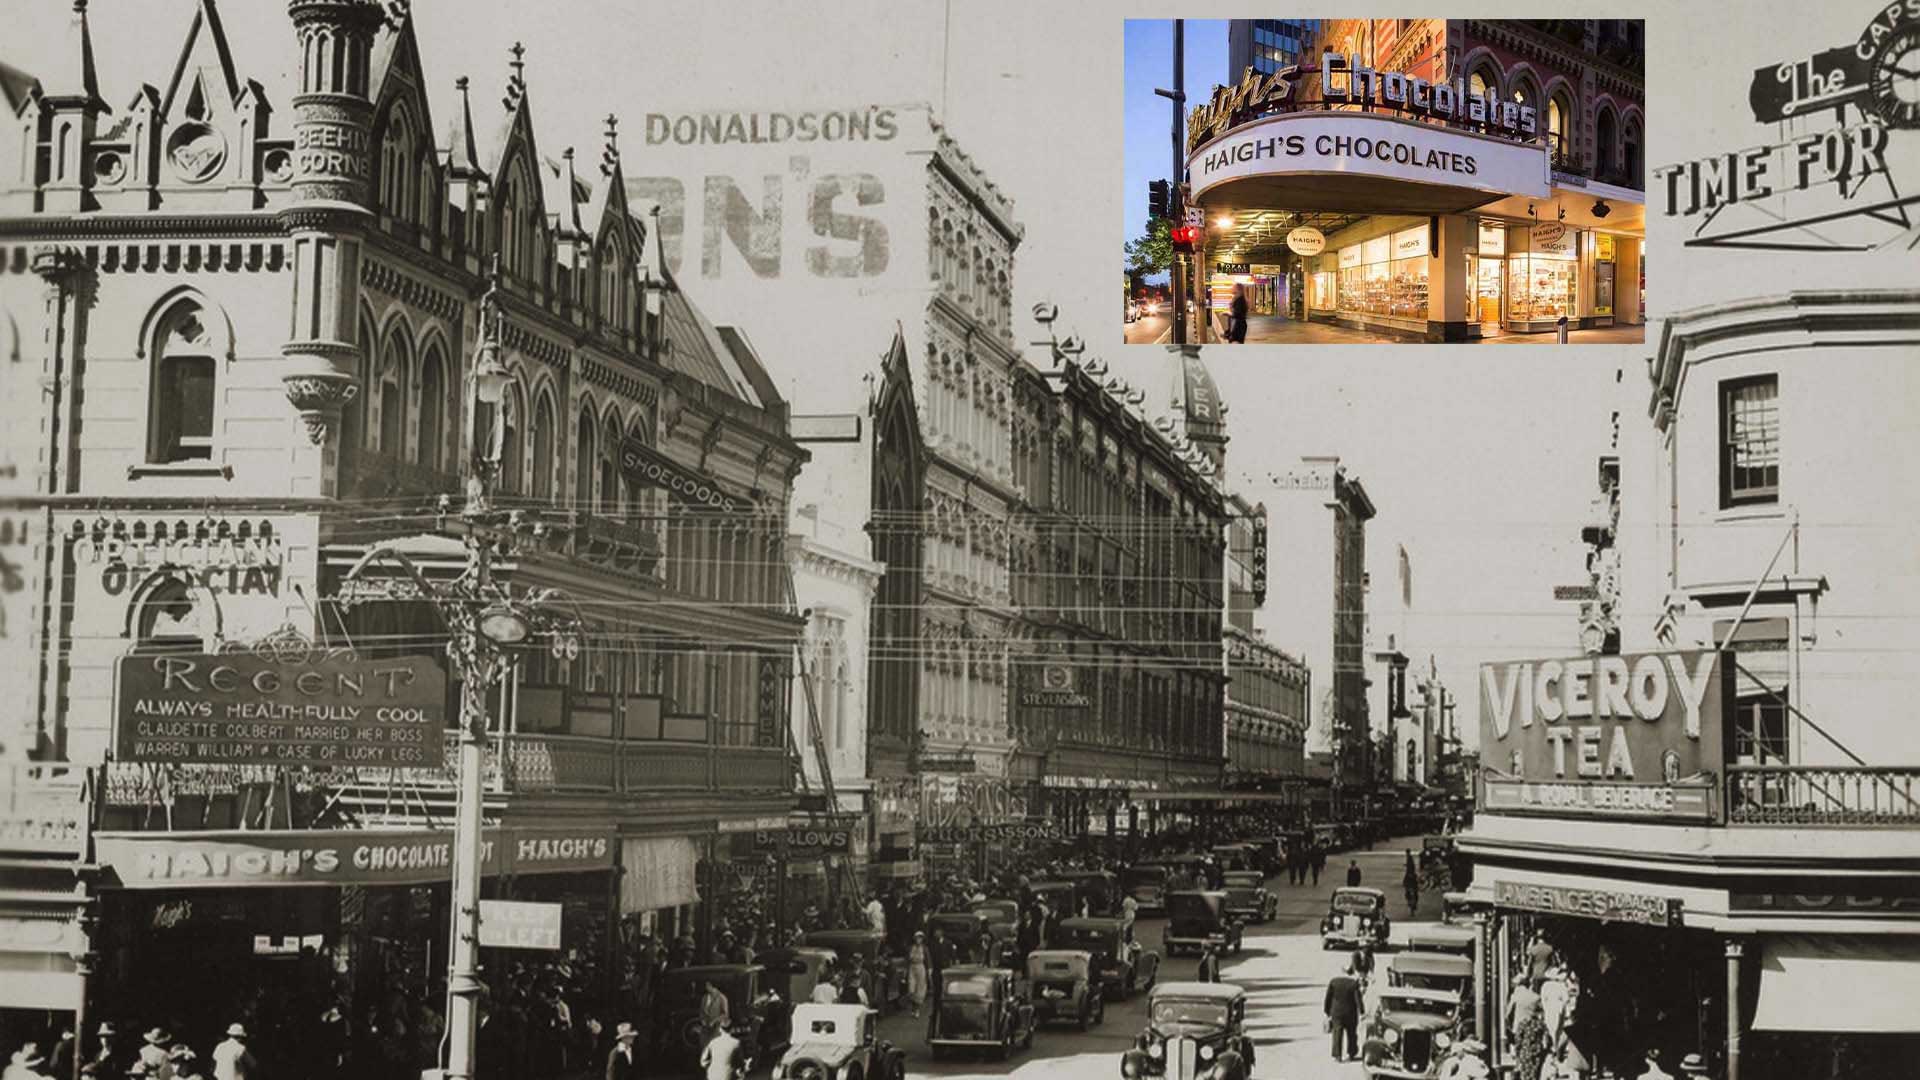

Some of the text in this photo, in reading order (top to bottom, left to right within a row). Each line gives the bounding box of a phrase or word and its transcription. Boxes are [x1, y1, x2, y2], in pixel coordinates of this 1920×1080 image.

[1322, 52, 1537, 133] Chocolates
[1776, 54, 1848, 114] The
[646, 104, 898, 145] DONALDSON'S
[1204, 135, 1478, 176] HAIGH'S CHOCOLATES
[1653, 124, 1889, 217] TIME FOR
[1292, 236, 1322, 245] HAIGH'S
[153, 656, 416, 696] REGENT
[134, 699, 429, 722] ALWAYS HEALTHFULLY COOL
[1481, 652, 1718, 742] VICEROY
[134, 741, 423, 761] WARREN WILLIAM CASE OF LUCKY LEGS
[137, 721, 423, 743] CLAUDETTE COLBERT MARRIED HER BOSS
[1546, 725, 1635, 780] TEA
[353, 843, 450, 870] CHOCOLATE
[516, 838, 607, 862] HAIGH'S
[755, 830, 847, 846] BRLOWS
